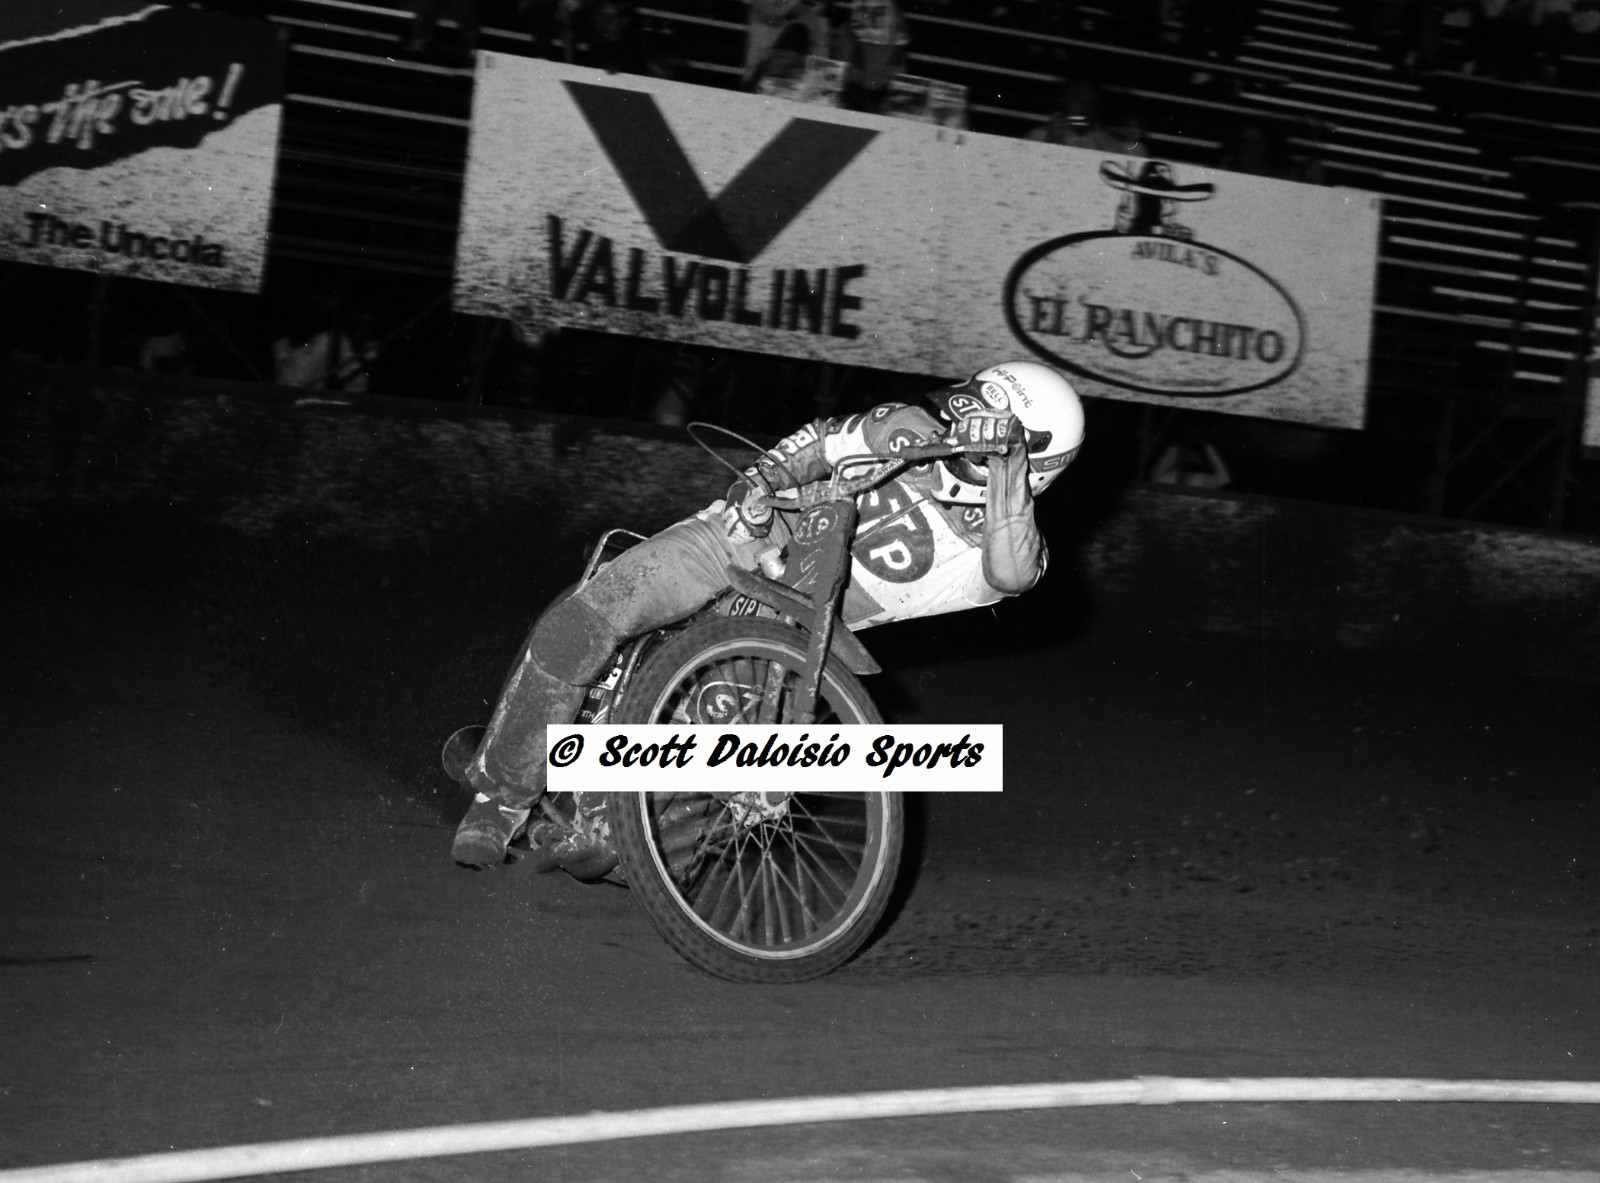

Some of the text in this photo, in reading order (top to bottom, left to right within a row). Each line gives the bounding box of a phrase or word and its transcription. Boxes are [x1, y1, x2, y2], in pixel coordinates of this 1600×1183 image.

[560, 79, 882, 264] V
[25, 211, 224, 267] The Uncola
[1131, 241, 1221, 276] AVILA'S
[546, 213, 865, 339] VALVOLINE
[1023, 290, 1285, 363] EL RANCHITO
[953, 398, 982, 413] ST
[986, 384, 1003, 404] BELL
